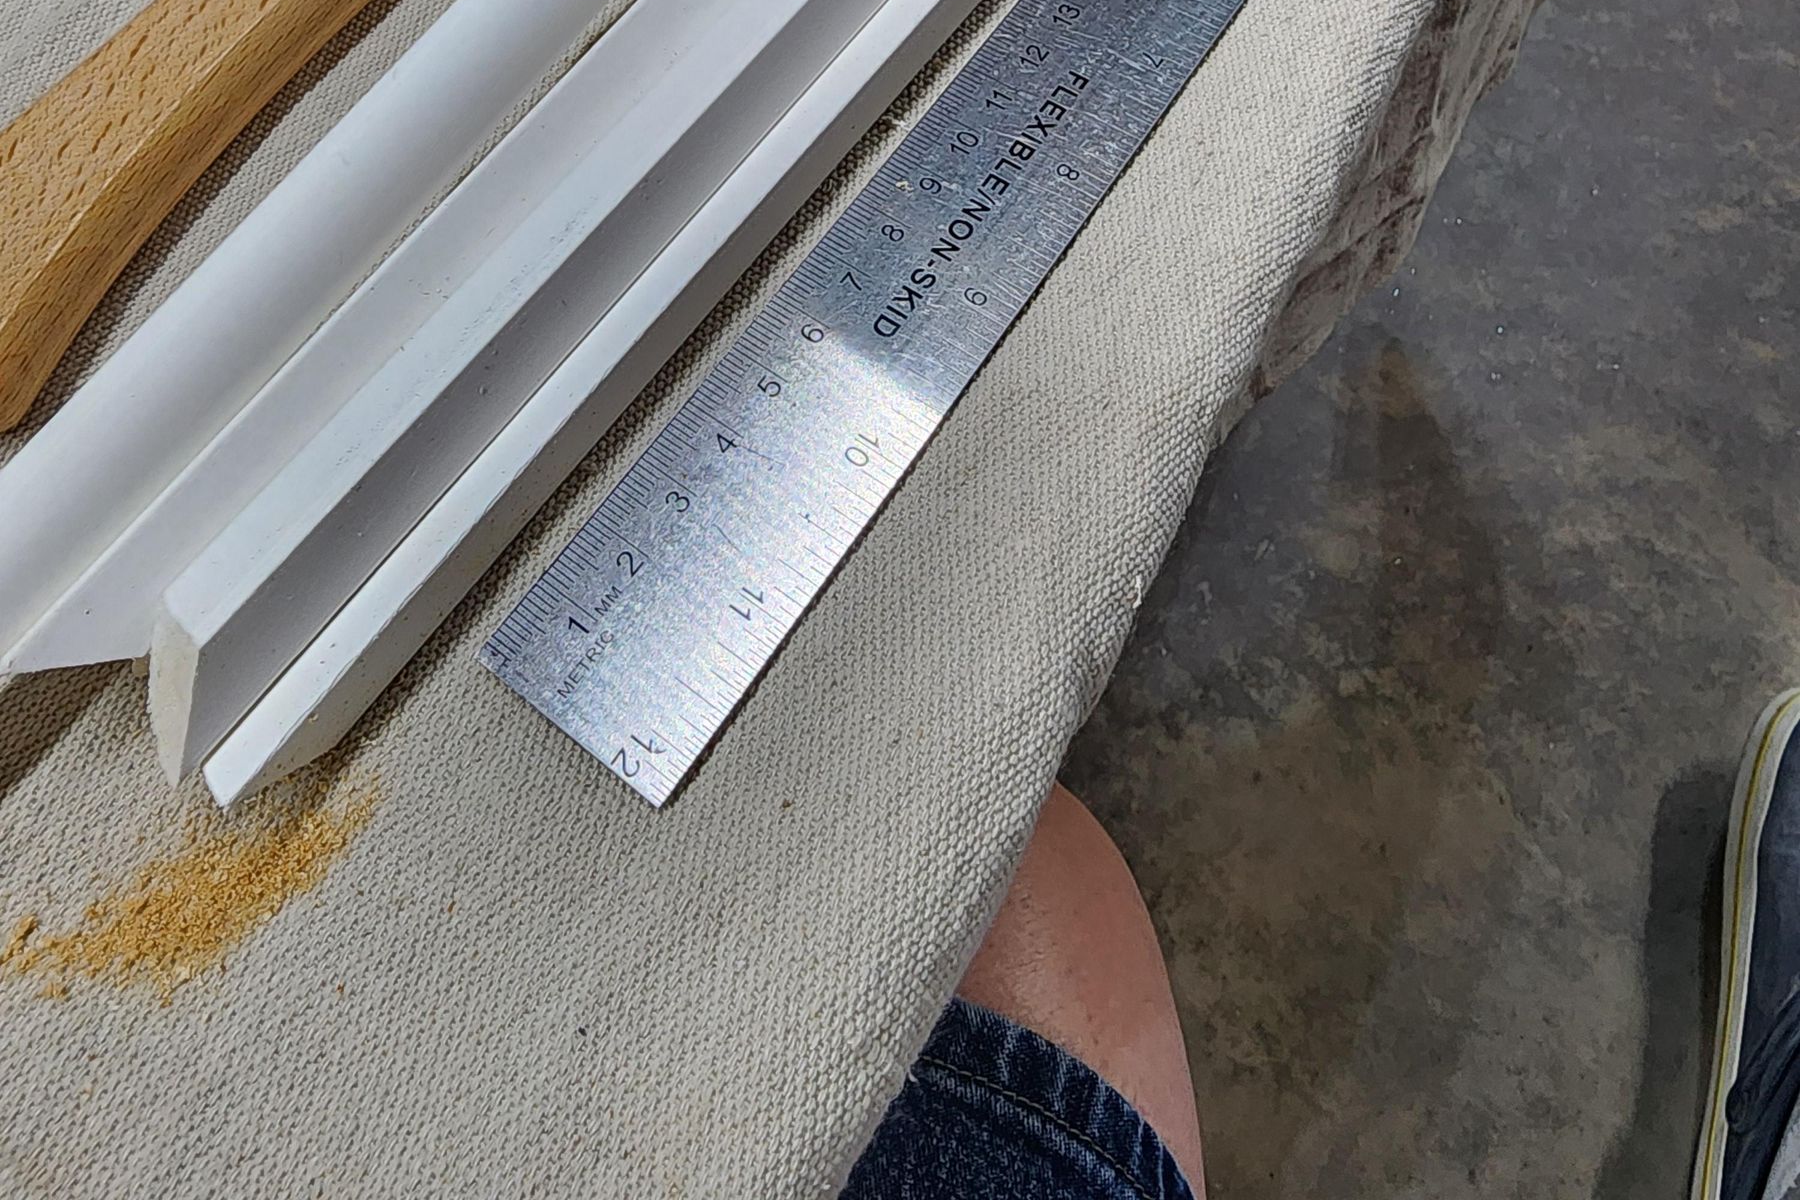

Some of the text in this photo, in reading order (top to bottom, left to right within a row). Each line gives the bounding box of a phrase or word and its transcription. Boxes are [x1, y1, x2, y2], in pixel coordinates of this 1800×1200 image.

[1142, 51, 1164, 69] 7
[1056, 163, 1080, 181] 8
[873, 70, 1090, 338] FLEXIBLE/NON-SKID
[964, 287, 988, 307] 9
[568, 616, 590, 634] 1
[617, 551, 644, 577] 2
[665, 491, 690, 513] 3
[716, 433, 738, 453] 4
[757, 375, 782, 397] 5
[801, 324, 825, 343] 6
[840, 272, 862, 291] 7
[881, 224, 905, 242] 8
[919, 177, 942, 195] 9
[951, 131, 979, 155] 10
[986, 90, 1013, 110] 11
[1020, 45, 1050, 67] 12
[1053, 4, 1080, 26] 13
[844, 433, 880, 467] 10
[594, 586, 623, 617] MM
[728, 587, 764, 621] 11
[557, 630, 615, 699] METRIC
[610, 734, 654, 778] 12
